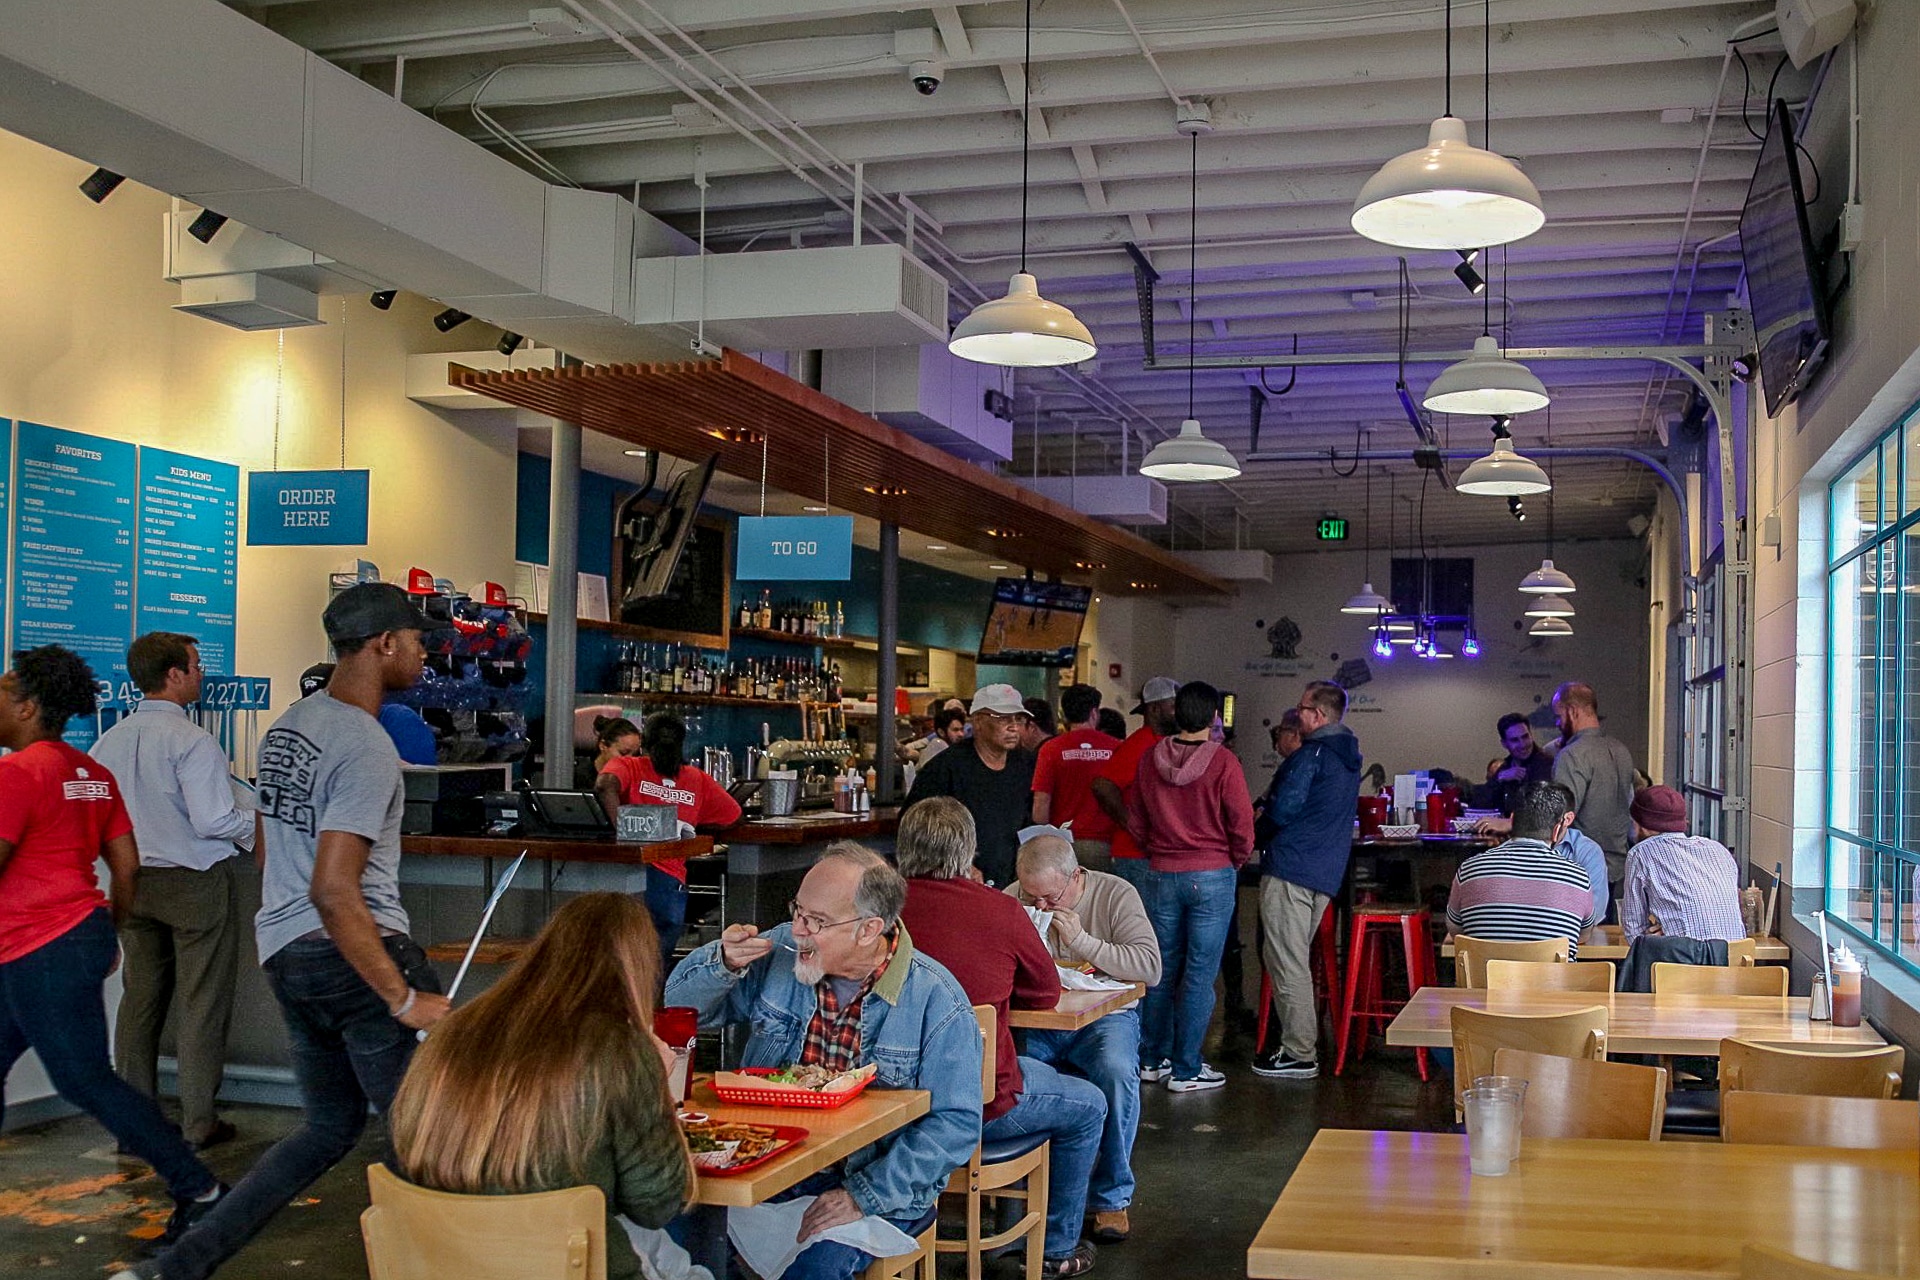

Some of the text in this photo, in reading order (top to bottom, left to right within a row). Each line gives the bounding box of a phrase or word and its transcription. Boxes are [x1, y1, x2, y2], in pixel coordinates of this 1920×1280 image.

[55, 444, 102, 461] FAVORITES
[170, 466, 212, 482] KIDS MENU
[278, 489, 337, 505] ORDER
[283, 511, 330, 527] HERE
[1322, 520, 1345, 539] EXIT
[771, 541, 817, 555] TO GO
[170, 592, 207, 605] DESSERTS
[624, 816, 653, 833] TIPS
